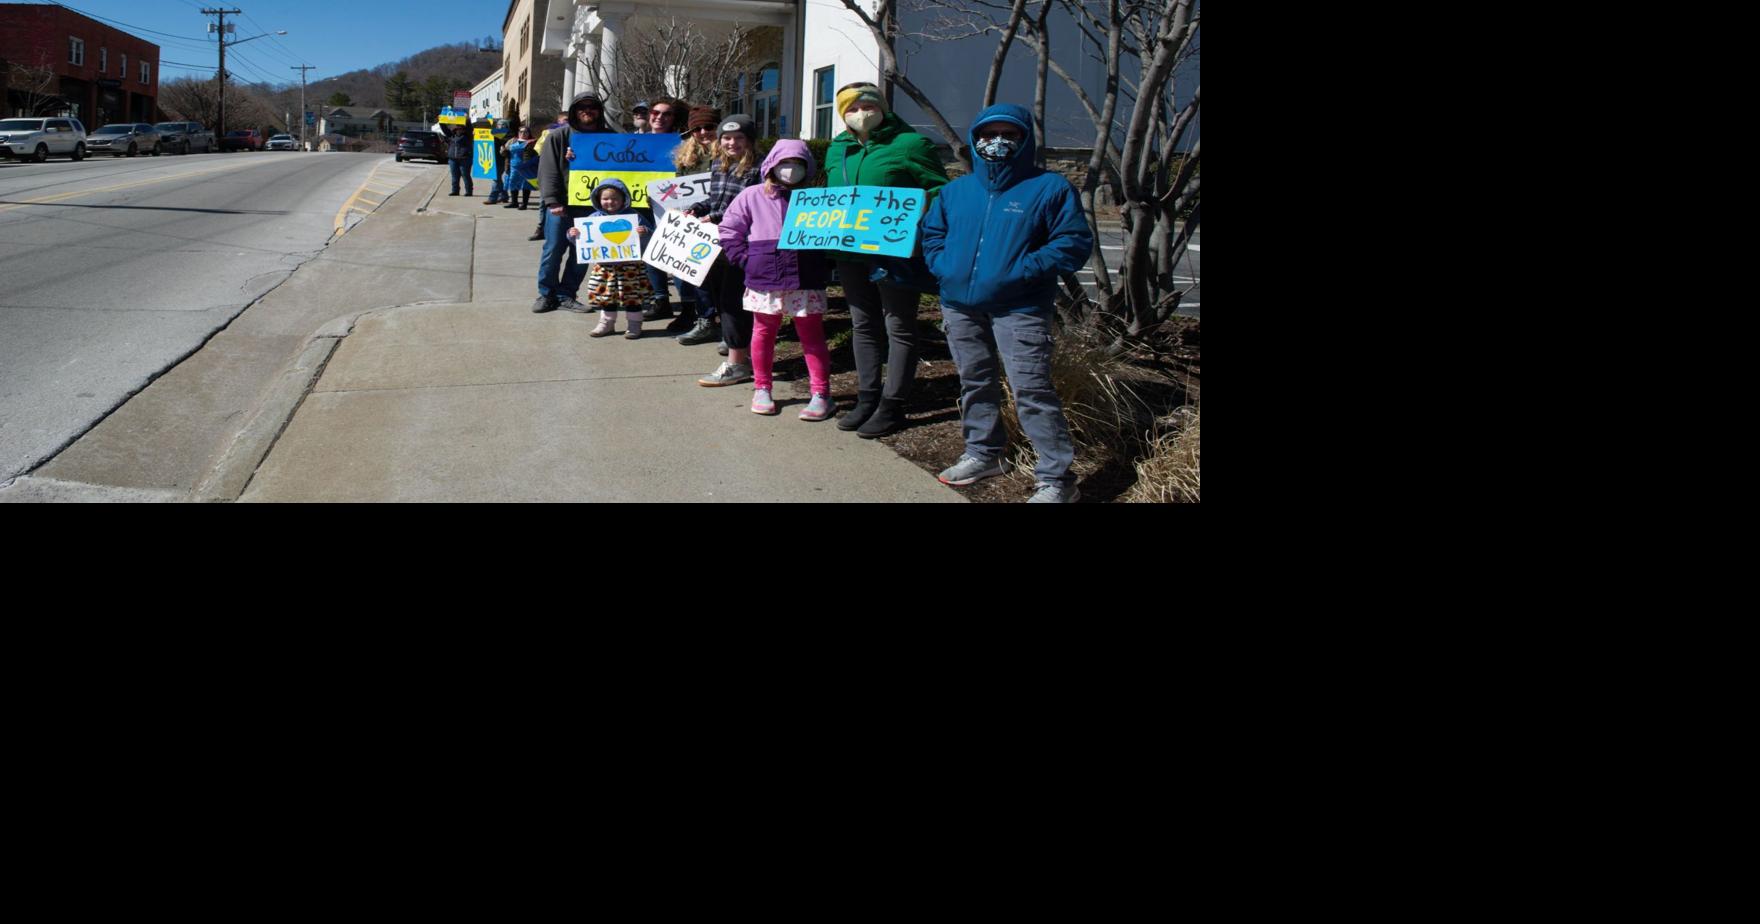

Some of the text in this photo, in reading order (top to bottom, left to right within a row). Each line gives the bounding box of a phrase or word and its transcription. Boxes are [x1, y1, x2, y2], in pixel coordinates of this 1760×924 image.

[795, 187, 917, 211] Protect the
[667, 212, 681, 227] We
[794, 209, 909, 231] PEOPLE of
[582, 221, 595, 243] I
[787, 230, 856, 247] Ukraine
[581, 244, 638, 260] UKRAINE
[650, 240, 697, 277] Ukraine
